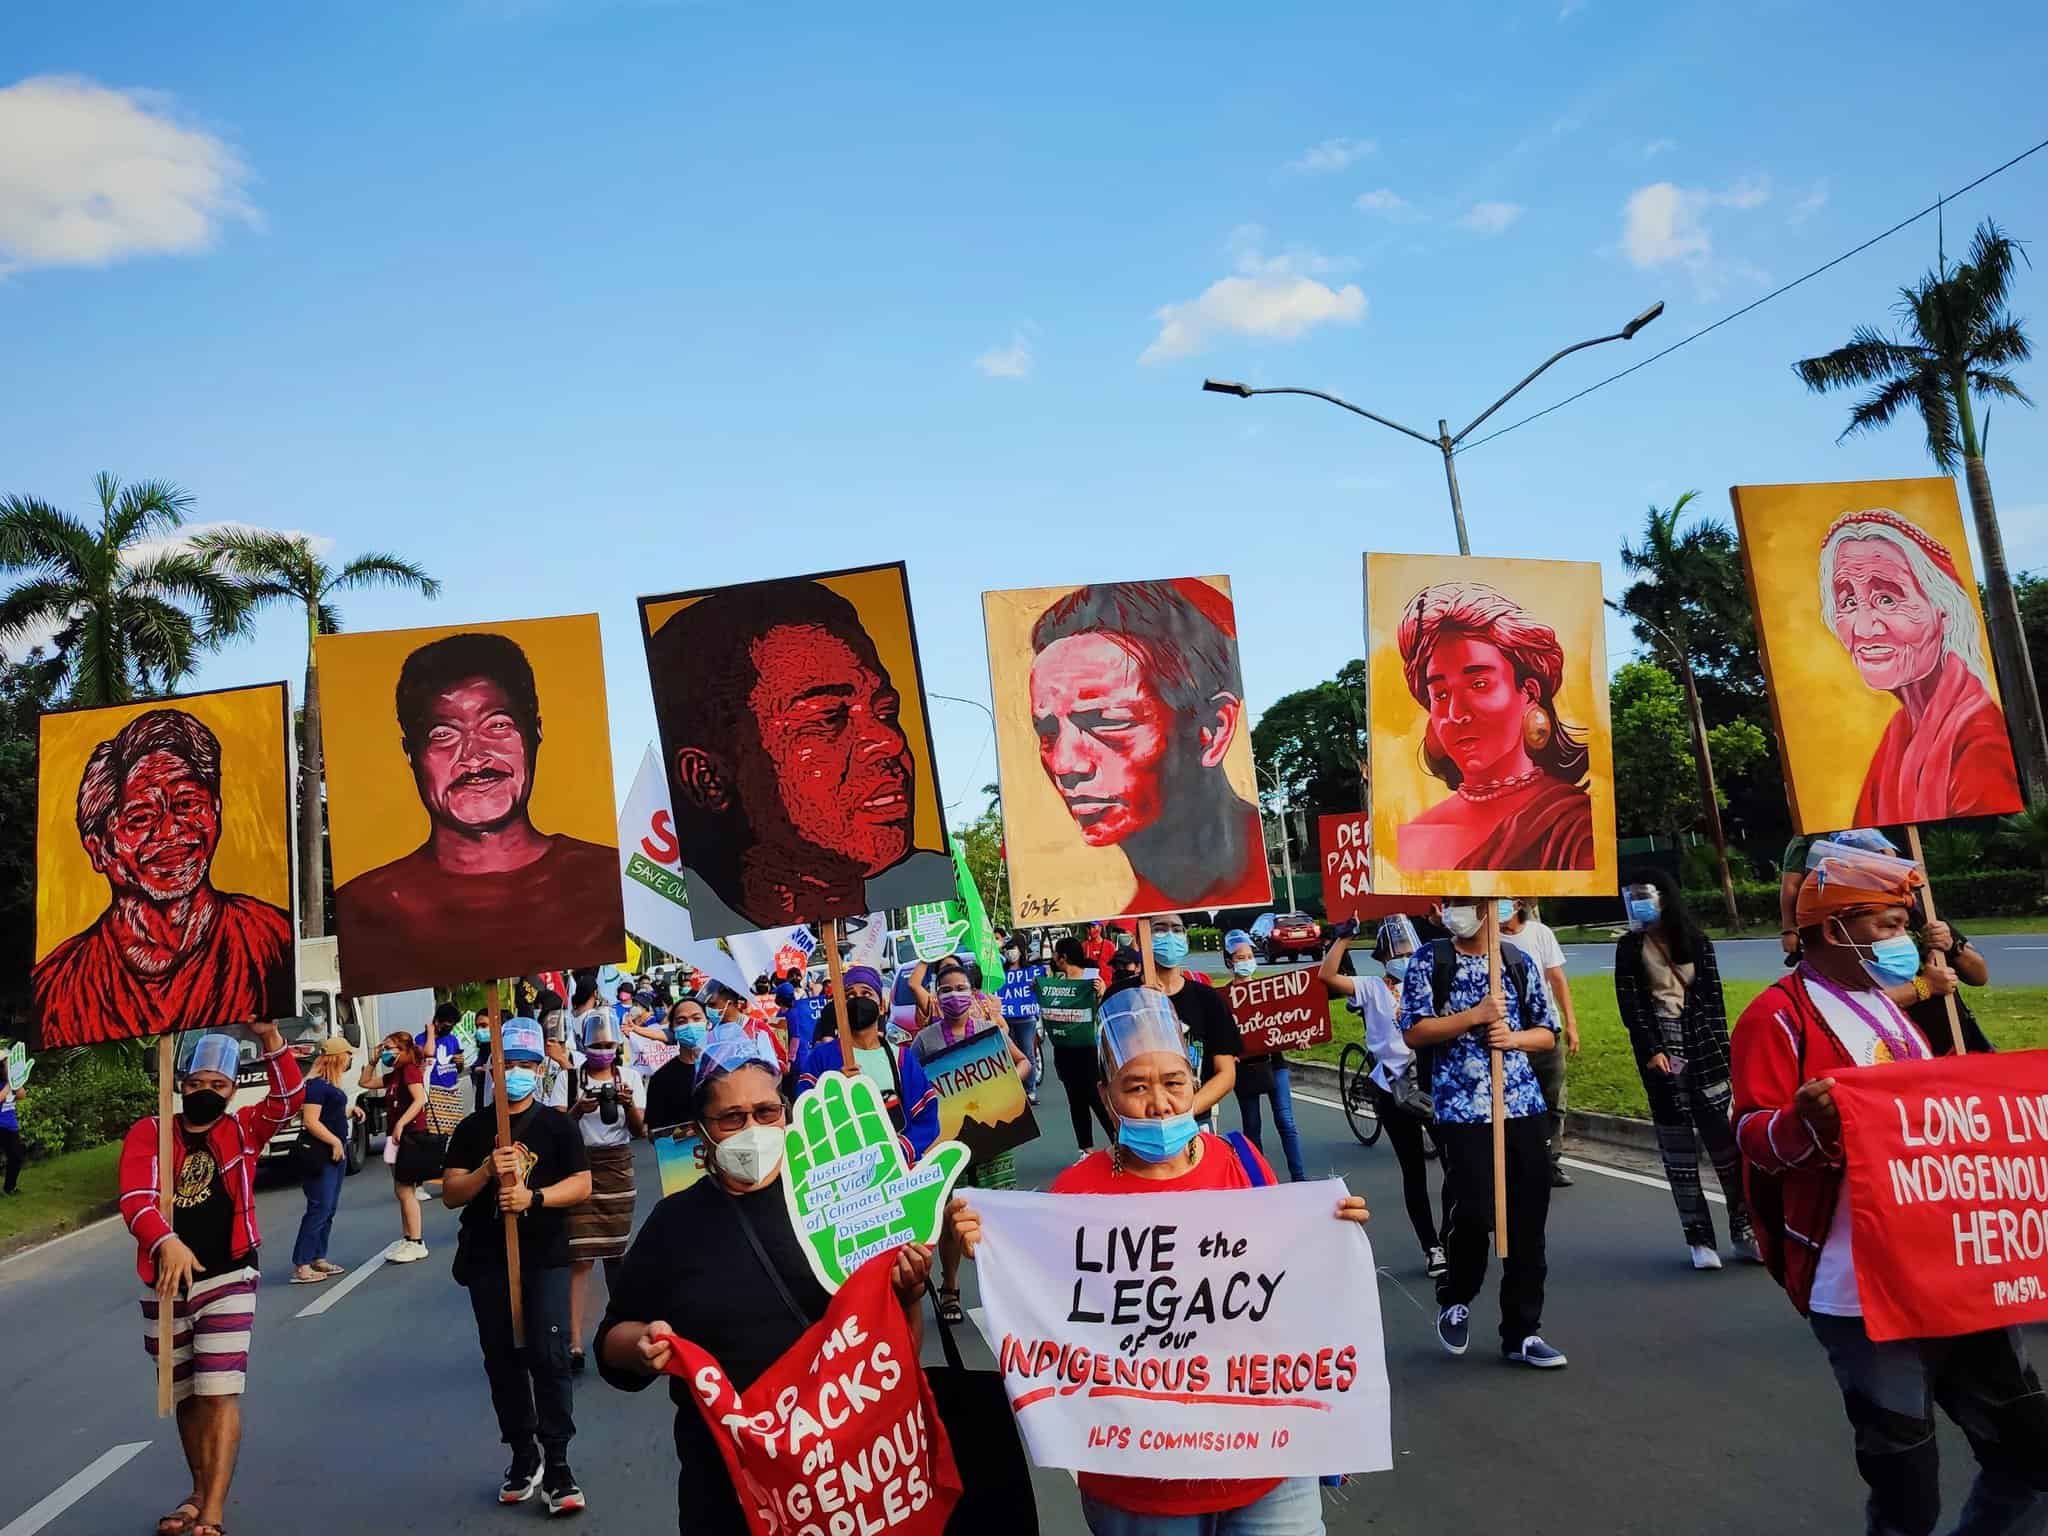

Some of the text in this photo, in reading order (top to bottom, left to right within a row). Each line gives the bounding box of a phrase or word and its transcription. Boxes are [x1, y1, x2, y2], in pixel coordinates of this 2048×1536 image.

[631, 860, 669, 888] SAVE
[1229, 970, 1310, 1008] DEFEND
[1264, 1017, 1325, 1046] Range!
[1894, 1095, 1991, 1146] LONG
[811, 1160, 857, 1184] Justice
[1888, 1154, 2048, 1205] INDIGENOU
[806, 1166, 941, 1230] of Climate Related
[809, 1189, 832, 1205] the
[839, 1207, 903, 1238] Disasters
[1075, 1225, 1248, 1274] LIVE the
[1067, 1270, 1286, 1336] LEGACY
[1000, 1333, 1357, 1395] INDIGENOUS HEROES
[802, 1438, 834, 1475] on
[1088, 1425, 1290, 1451] ILPS COMMISSION 10
